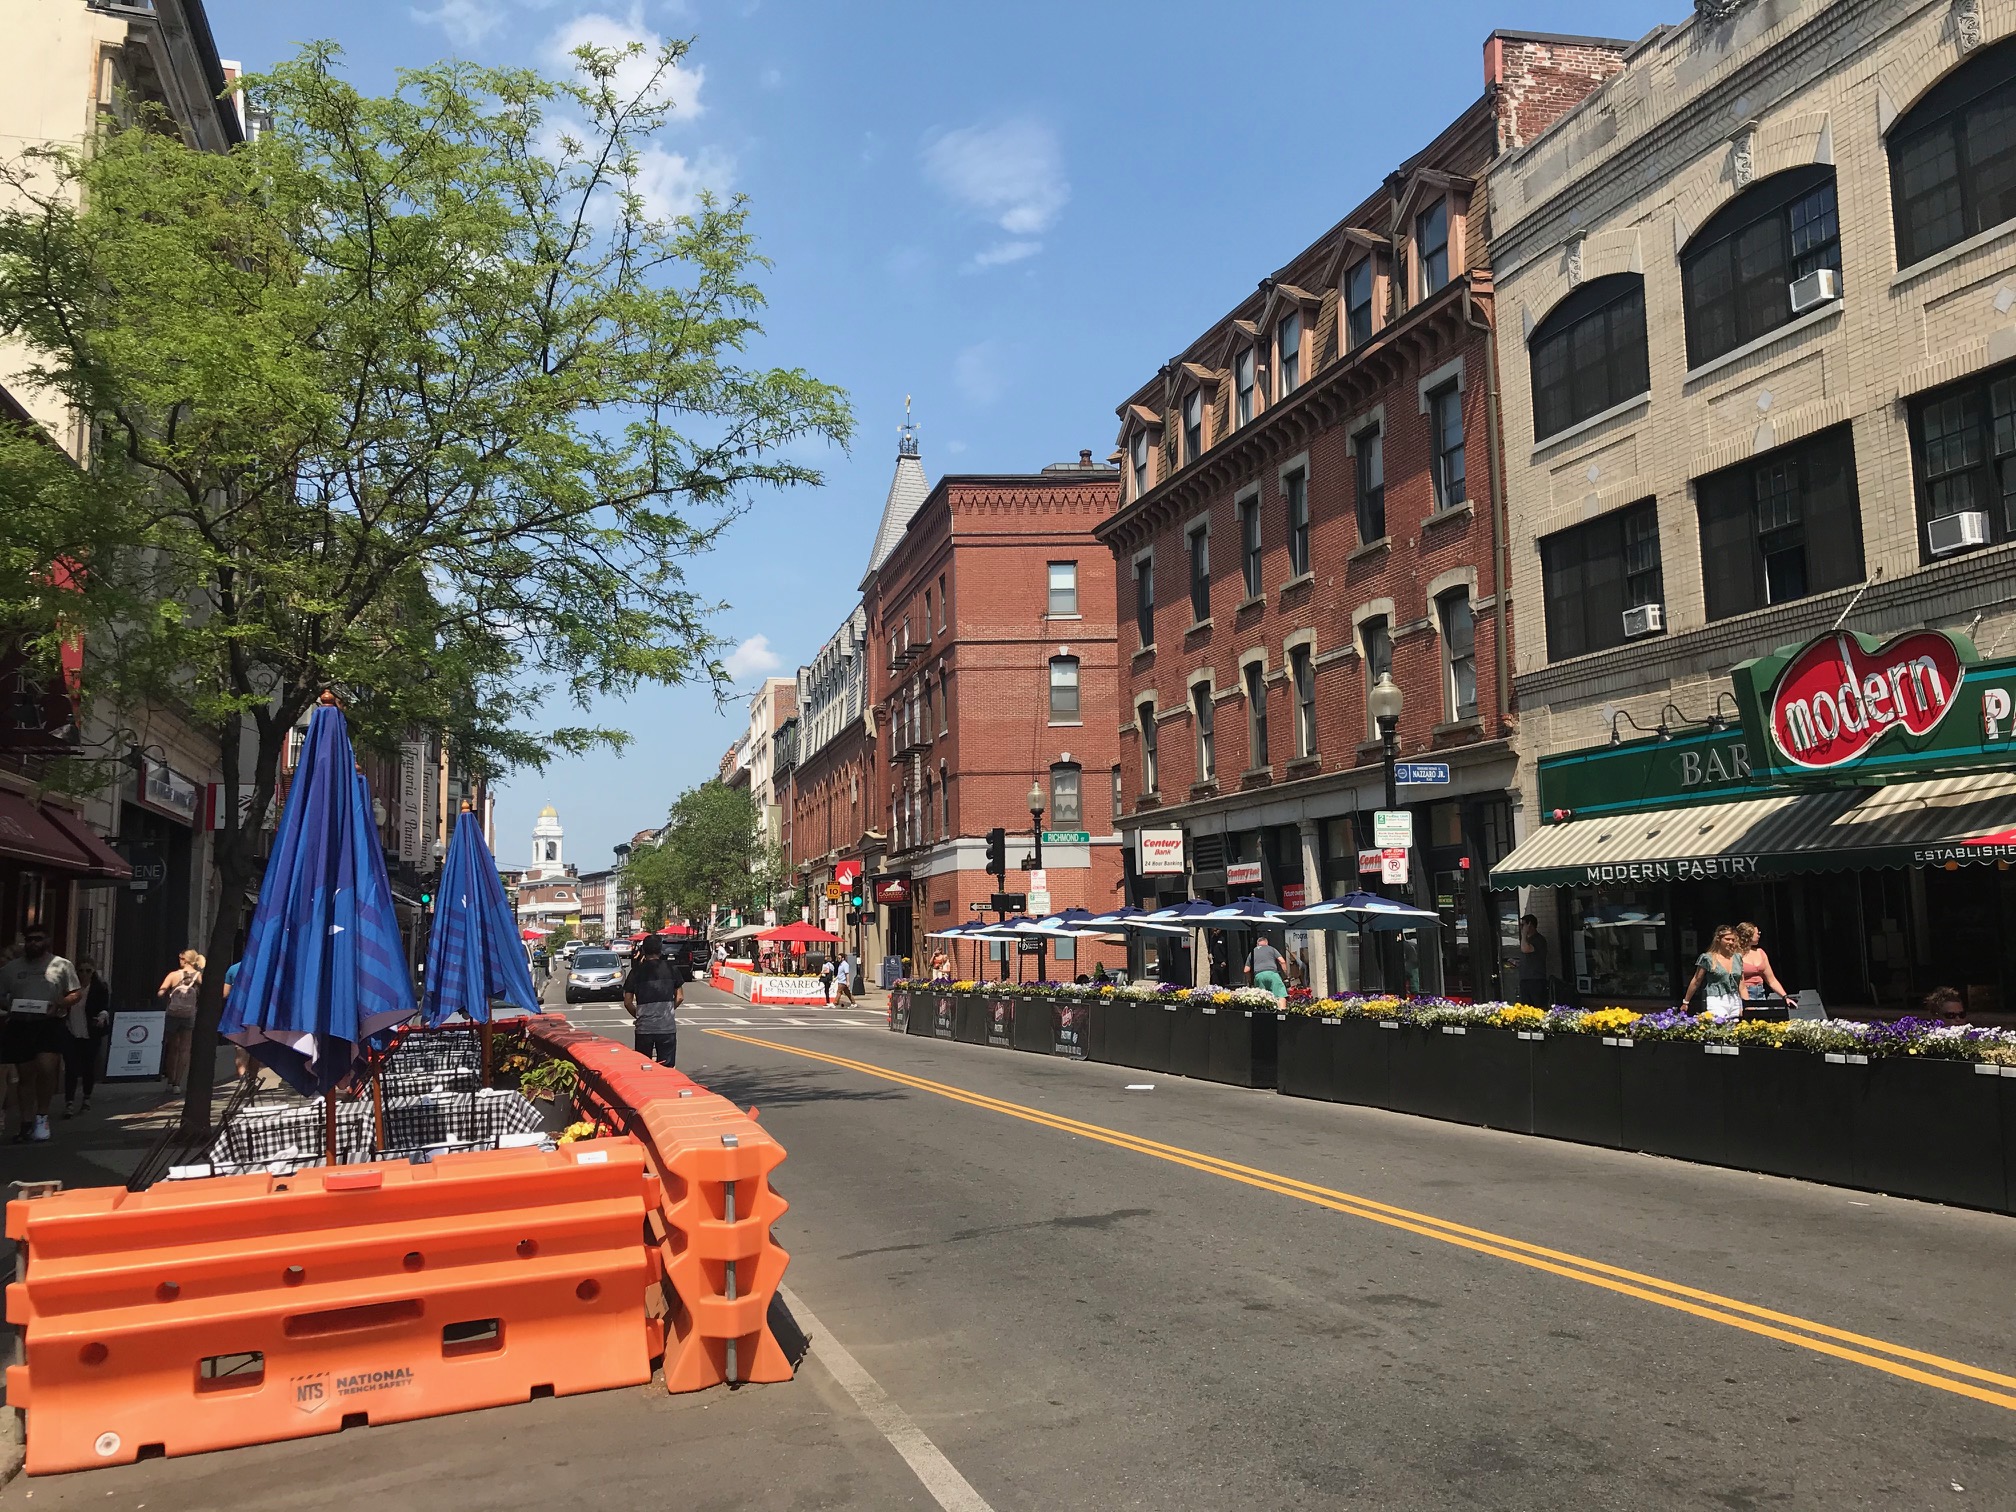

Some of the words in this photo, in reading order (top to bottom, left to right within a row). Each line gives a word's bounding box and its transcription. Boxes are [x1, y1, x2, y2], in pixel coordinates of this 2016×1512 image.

[1784, 636, 1947, 753] modern
[1412, 770, 1437, 778] NAZZARO
[1679, 743, 1751, 787] BAR
[404, 819, 417, 857] Panino
[1047, 833, 1079, 842] RICHMOND
[1143, 839, 1181, 849] Century
[1587, 862, 1669, 881] MODERN
[1677, 856, 1759, 876] PASTRY
[1293, 932, 1308, 941] Progra
[336, 1367, 414, 1389] NATIONAL
[338, 1384, 376, 1396] TRENCH
[378, 1379, 412, 1390] SAFETY
[297, 1382, 324, 1402] NTS
